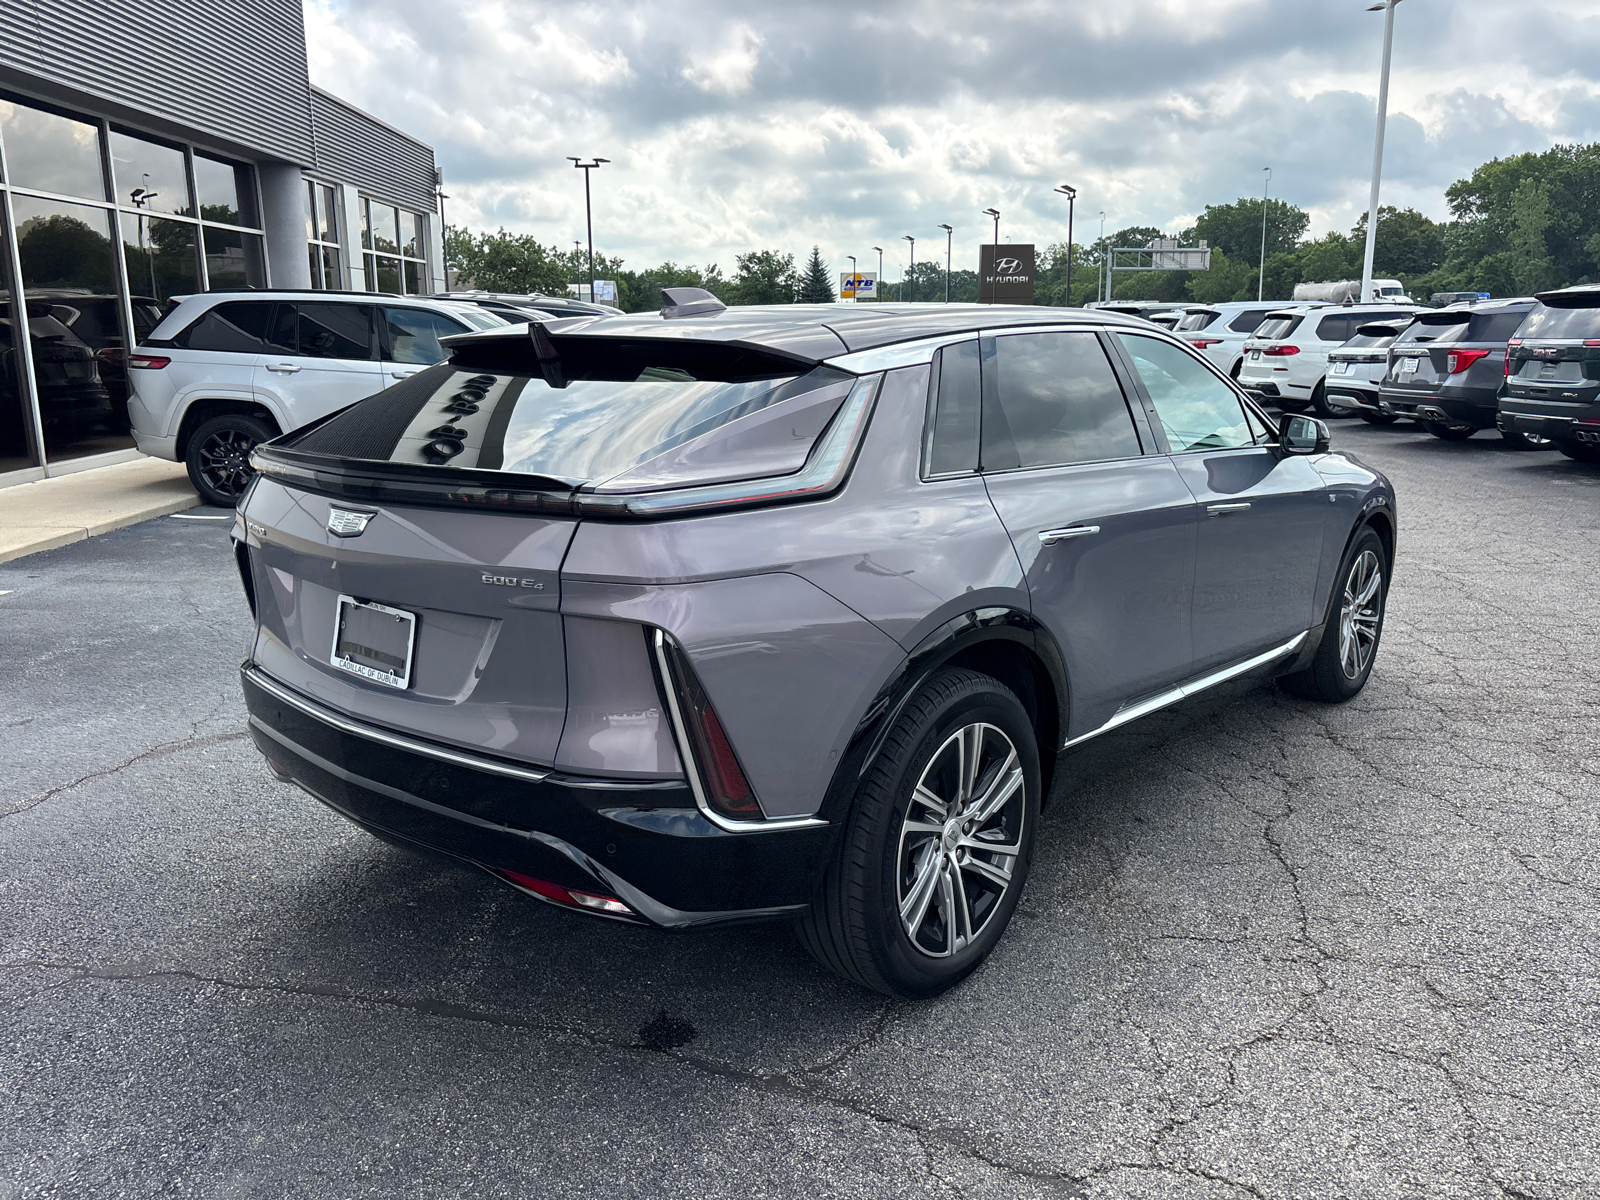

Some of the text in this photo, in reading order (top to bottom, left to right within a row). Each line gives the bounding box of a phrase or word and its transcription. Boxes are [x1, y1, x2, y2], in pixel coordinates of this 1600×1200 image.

[845, 279, 874, 287] NTB
[986, 276, 1029, 284] HYUNDAI
[1533, 348, 1558, 357] GMC
[481, 574, 545, 591] 600 E4
[338, 659, 399, 686] CADILLAC OF DUBLIN
